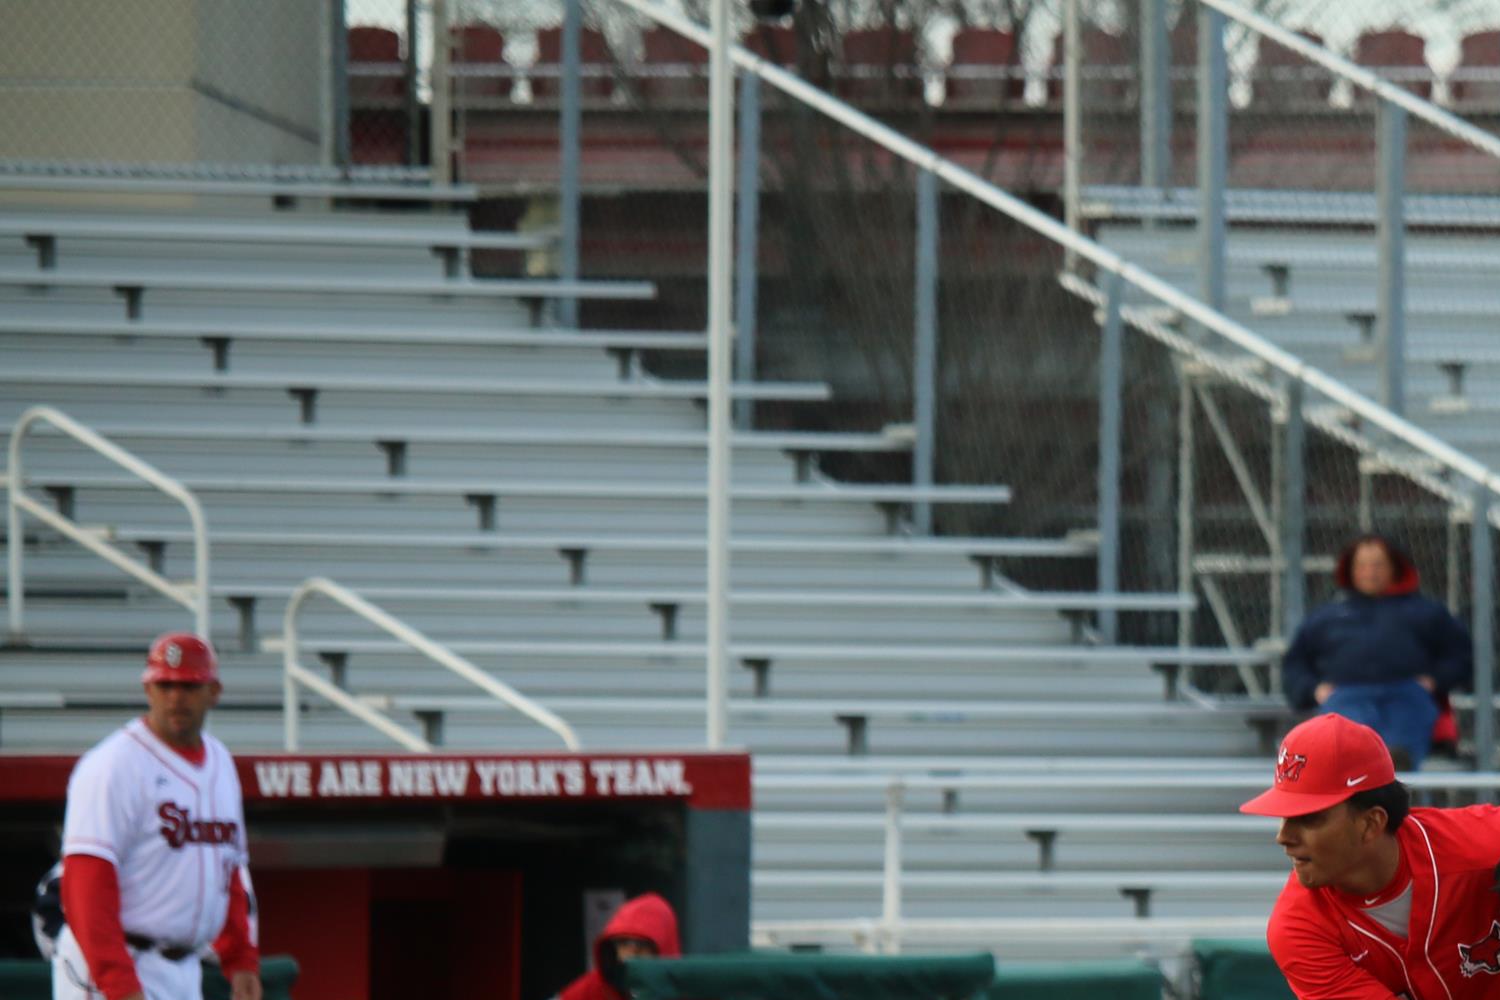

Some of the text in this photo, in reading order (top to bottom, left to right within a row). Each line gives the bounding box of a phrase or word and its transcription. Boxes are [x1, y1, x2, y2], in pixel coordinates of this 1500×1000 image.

[254, 759, 692, 796] WE ARE NEW YORK'S TEAM.
